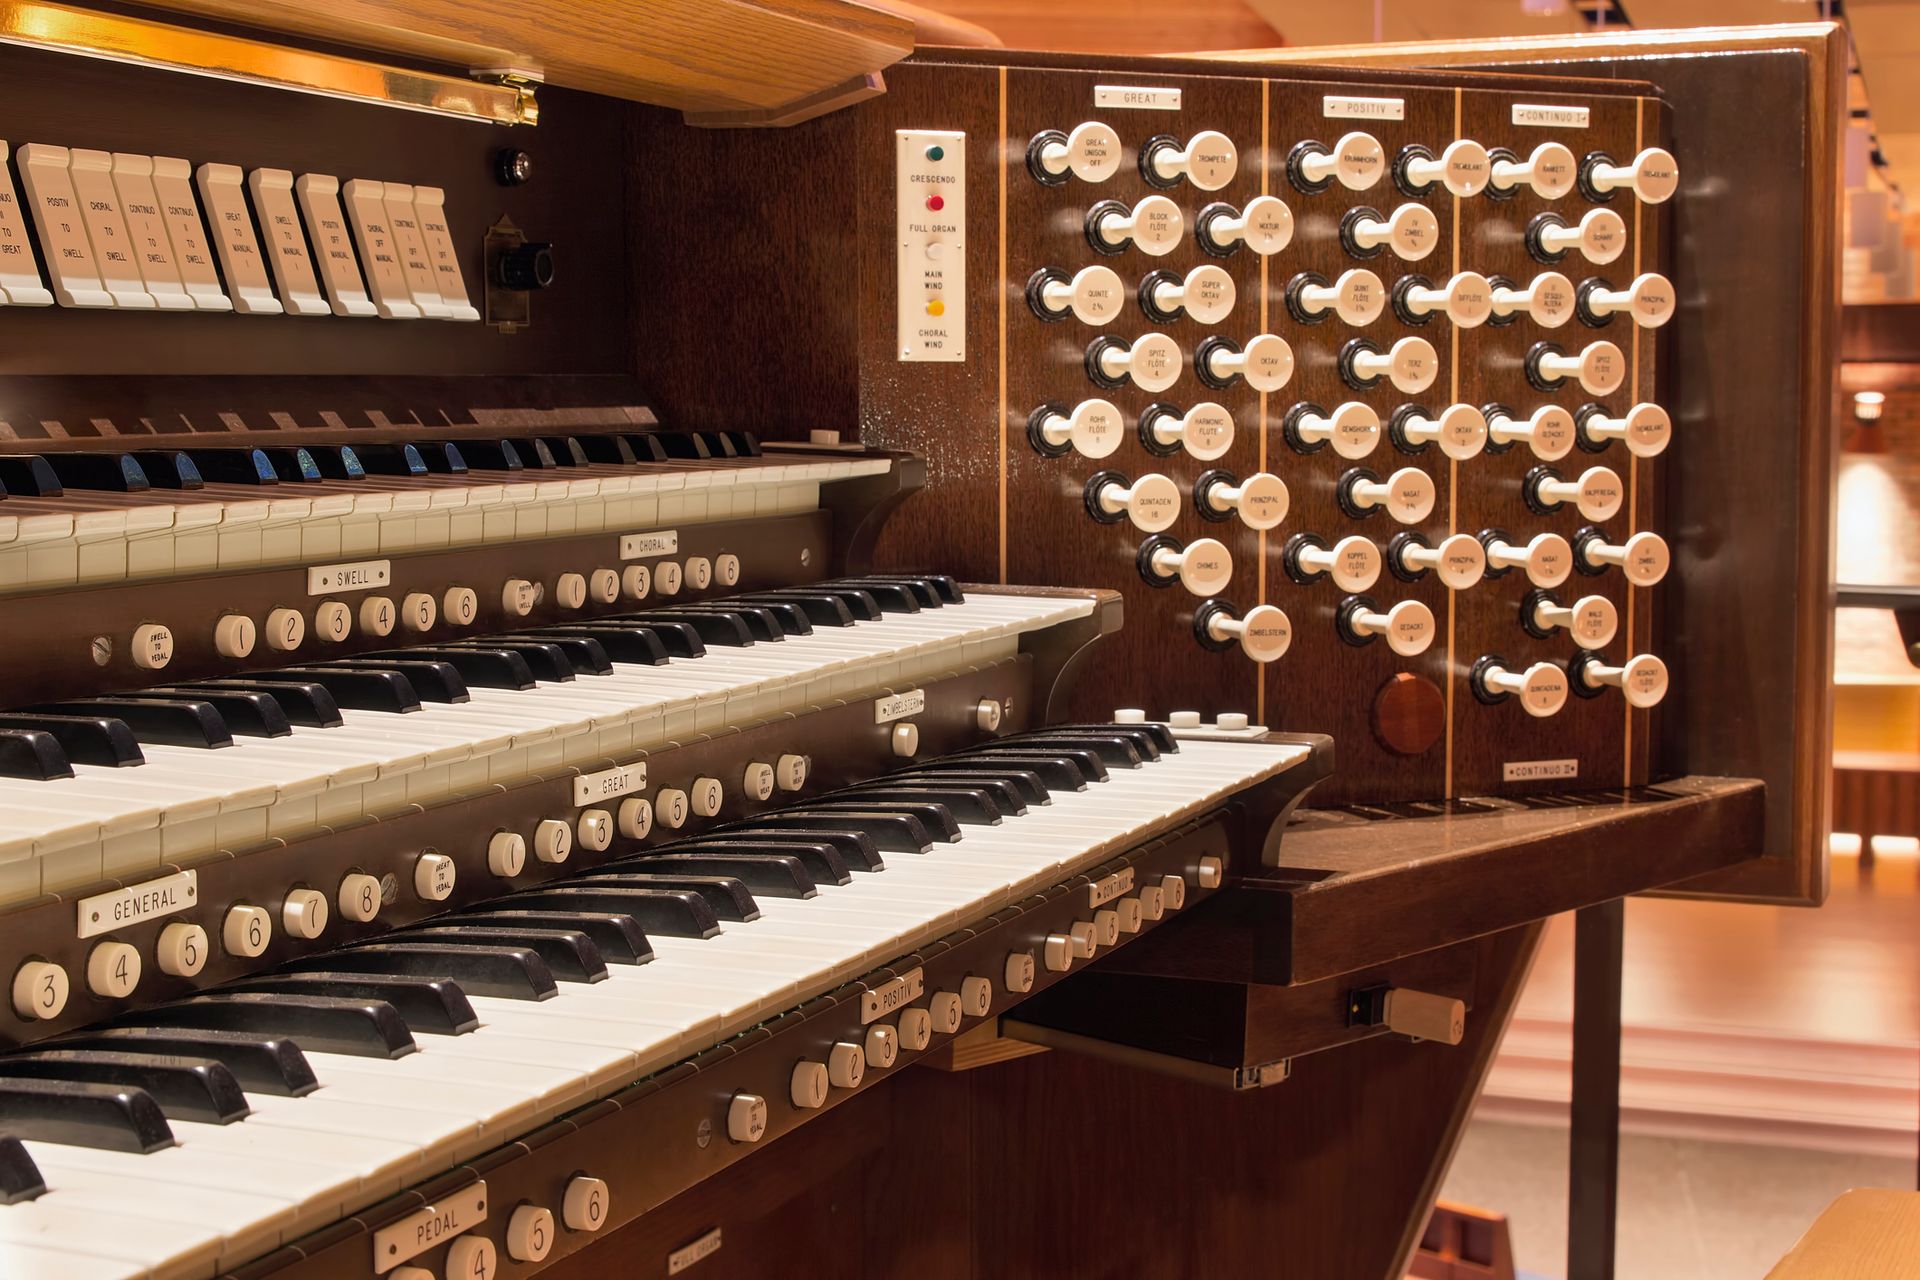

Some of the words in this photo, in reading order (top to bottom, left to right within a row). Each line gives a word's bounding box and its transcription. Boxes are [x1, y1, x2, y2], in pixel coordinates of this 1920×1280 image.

[1124, 93, 1156, 103] GREAT
[1347, 103, 1386, 114] POSITIV
[1526, 111, 1572, 121] CONTINUO
[1085, 149, 1107, 157] UNISON
[1198, 155, 1226, 163] TROMPETE
[1344, 155, 1378, 163] KRUMMHORN
[1453, 163, 1483, 171] TREMULANT
[910, 175, 956, 184] CRESCENDO
[47, 197, 69, 207] POSITIV
[90, 201, 113, 212] CHORAL
[129, 204, 155, 215] CONTINUO
[168, 206, 194, 217] CONTINUO
[225, 212, 241, 221] GREAT
[275, 216, 292, 225] SWELL
[2, 227, 12, 237] TO
[61, 223, 70, 232] TO
[104, 227, 113, 236] TO
[910, 224, 927, 232] FULL
[932, 225, 957, 233] ORGAN
[1150, 222, 1167, 231] FLÖTE
[234, 228, 242, 237] TO
[284, 231, 292, 240] TO
[1404, 229, 1424, 237] ZIMBEL
[147, 238, 156, 247] TO
[187, 239, 195, 248] TO
[1, 244, 21, 255] GREAT
[63, 249, 84, 259] SWELL
[232, 244, 253, 253] MANUAL
[282, 247, 302, 256] MANUAL
[106, 252, 127, 261] SWELL
[147, 254, 167, 263] SWELL
[185, 255, 205, 264] SWELL
[924, 282, 943, 290] WIND
[1202, 281, 1220, 289] SUPER
[1088, 290, 1108, 298] QUINTE
[919, 329, 948, 337] CHORAL
[924, 341, 943, 349] WIND
[1148, 360, 1165, 368] FLÖTE
[1408, 359, 1422, 368] TERZ
[1089, 425, 1106, 434] FLÖTE
[1455, 426, 1472, 434] OKTAV
[1403, 490, 1419, 498] NASAT
[1139, 498, 1171, 506] QUINTADEN
[639, 538, 665, 552] CHORAL
[1347, 552, 1368, 560] KOPPEL
[728, 560, 734, 580] 6
[1197, 562, 1218, 570] CHIMES
[337, 569, 369, 586] SWELL
[669, 569, 675, 589] 4
[699, 564, 705, 583] 5
[607, 576, 614, 596] 2
[638, 572, 644, 593] 3
[420, 601, 428, 624] 5
[462, 596, 470, 618] 6
[334, 609, 343, 634] 3
[379, 605, 388, 628] 4
[287, 617, 296, 642] 2
[150, 632, 168, 642] SWELL
[240, 624, 244, 650] 1
[151, 652, 168, 662] PEDAL
[887, 698, 920, 716] ZIMBELSTERN
[1515, 766, 1561, 776] CONTINUO
[602, 774, 629, 794] GREAT
[708, 787, 716, 809] 6
[673, 797, 682, 821] 5
[637, 806, 645, 830] 4
[598, 818, 606, 843] 3
[556, 828, 564, 855] 2
[511, 842, 515, 869] 1
[435, 860, 450, 872] GREAT
[439, 873, 445, 881] TO
[436, 882, 451, 894] PEDAL
[1104, 876, 1128, 899] CONTINUO
[114, 887, 176, 921] GENERAL
[362, 885, 372, 913] 8
[308, 899, 319, 929] 7
[1133, 904, 1138, 925] 4
[249, 917, 261, 947] 6
[185, 935, 197, 966] 5
[115, 954, 127, 986] 4
[43, 975, 56, 1008] 3
[883, 984, 912, 1010] POSITIV
[979, 984, 986, 1008] 6
[950, 1001, 956, 1025] 5
[918, 1016, 925, 1041] 4
[884, 1034, 891, 1059] 3
[851, 1053, 858, 1080] 2
[816, 1075, 820, 1100] 1
[589, 1190, 600, 1221] 6
[416, 1210, 459, 1246] PEDAL
[533, 1217, 544, 1251] 5
[474, 1249, 485, 1280] 4
